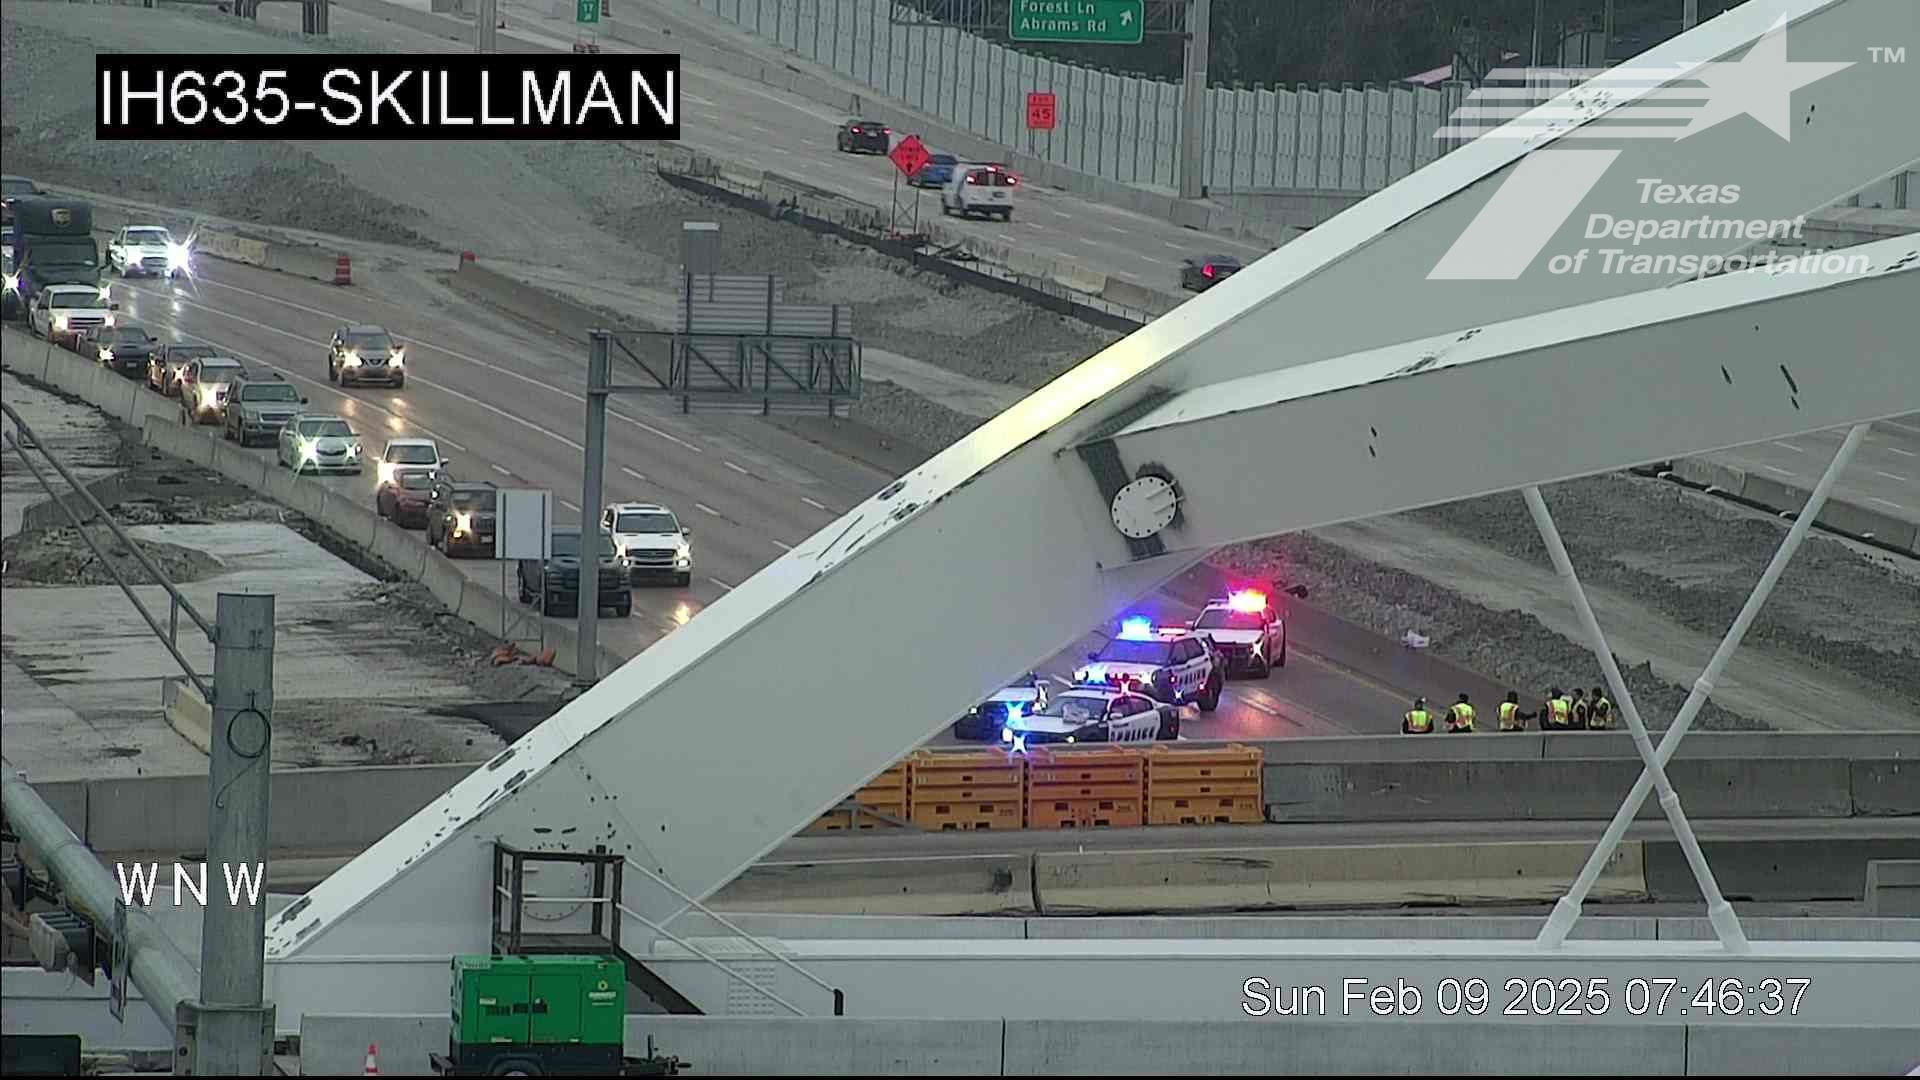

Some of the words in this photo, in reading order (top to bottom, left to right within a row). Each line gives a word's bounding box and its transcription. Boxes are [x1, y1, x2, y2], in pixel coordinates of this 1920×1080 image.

[1021, 0, 1069, 14] Forest
[1078, 1, 1095, 15] Ln
[1021, 17, 1079, 32] Abrams
[1087, 19, 1107, 33] Rd
[1032, 108, 1051, 120] 45
